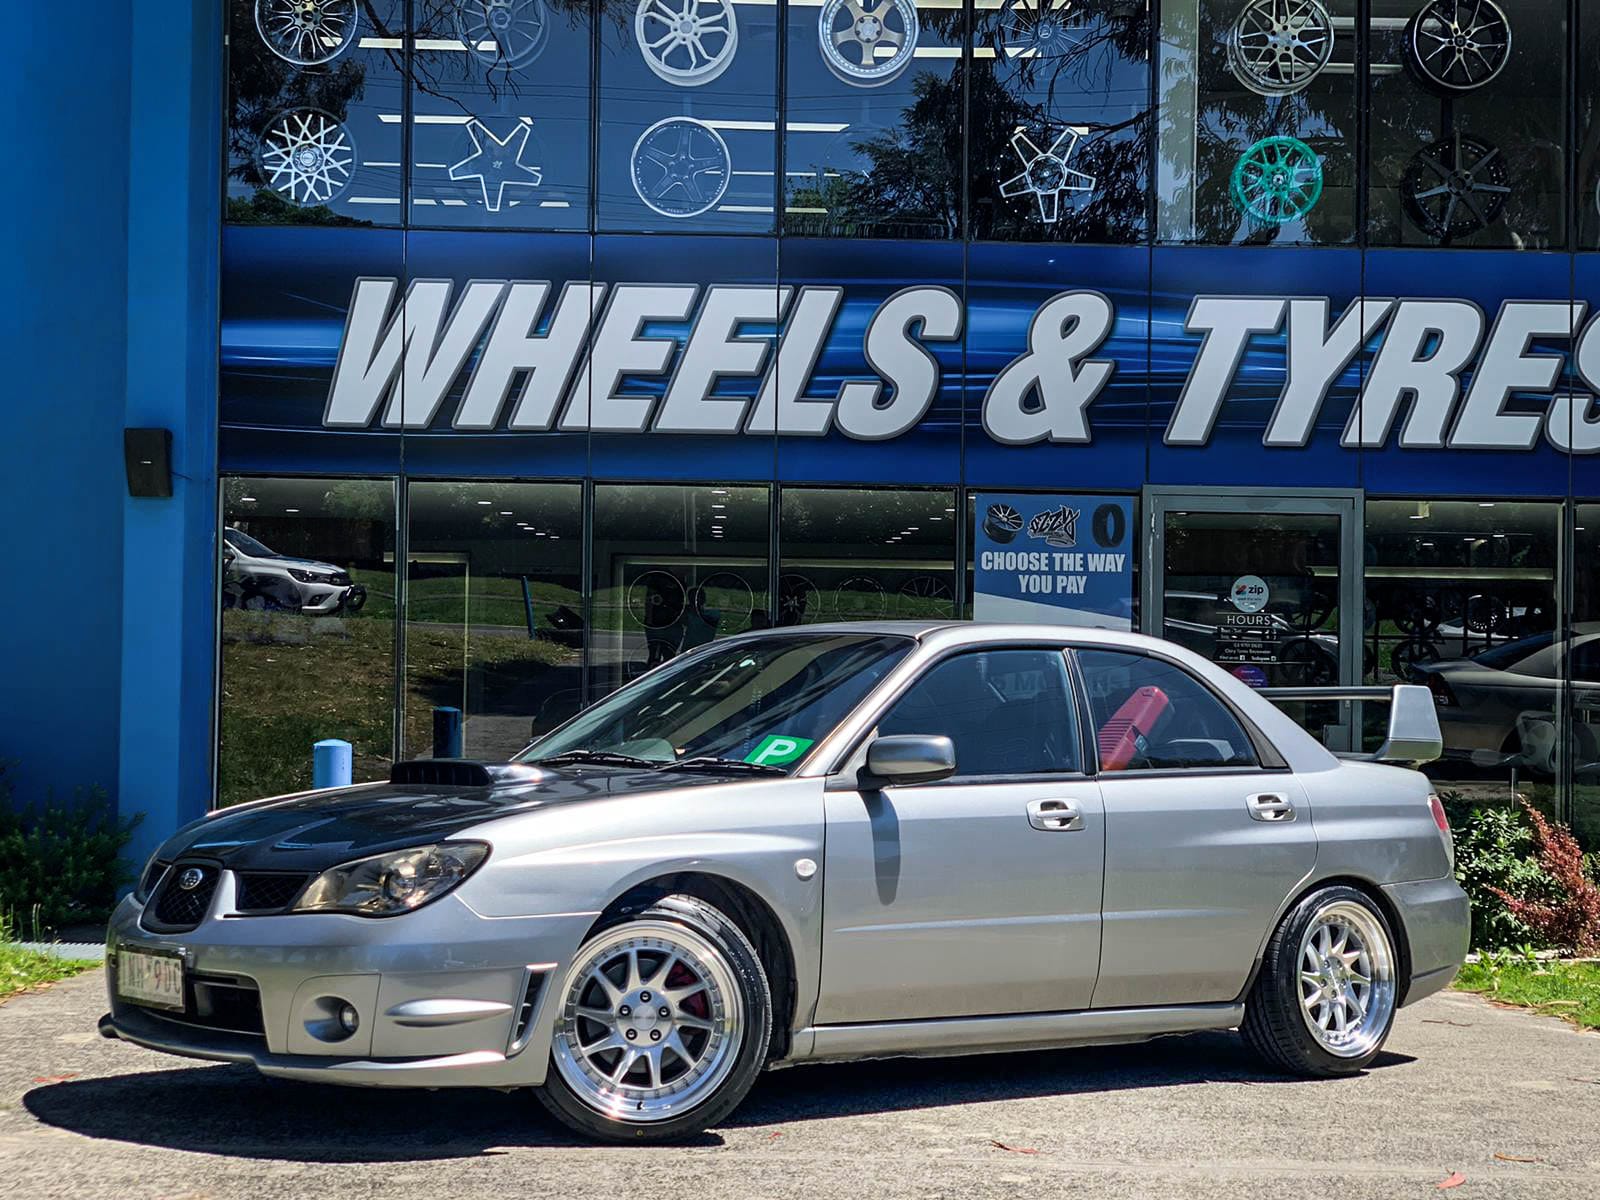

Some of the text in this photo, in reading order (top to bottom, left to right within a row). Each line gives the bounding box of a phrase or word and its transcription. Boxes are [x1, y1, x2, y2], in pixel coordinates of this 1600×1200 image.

[321, 276, 961, 440] WHEELS
[981, 288, 1114, 447] &
[981, 551, 1126, 572] CHOOSE THE WAY
[1018, 574, 1087, 594] YOU PAY
[1248, 584, 1264, 596] zip
[1226, 615, 1271, 625] HOURS
[754, 738, 797, 764] P
